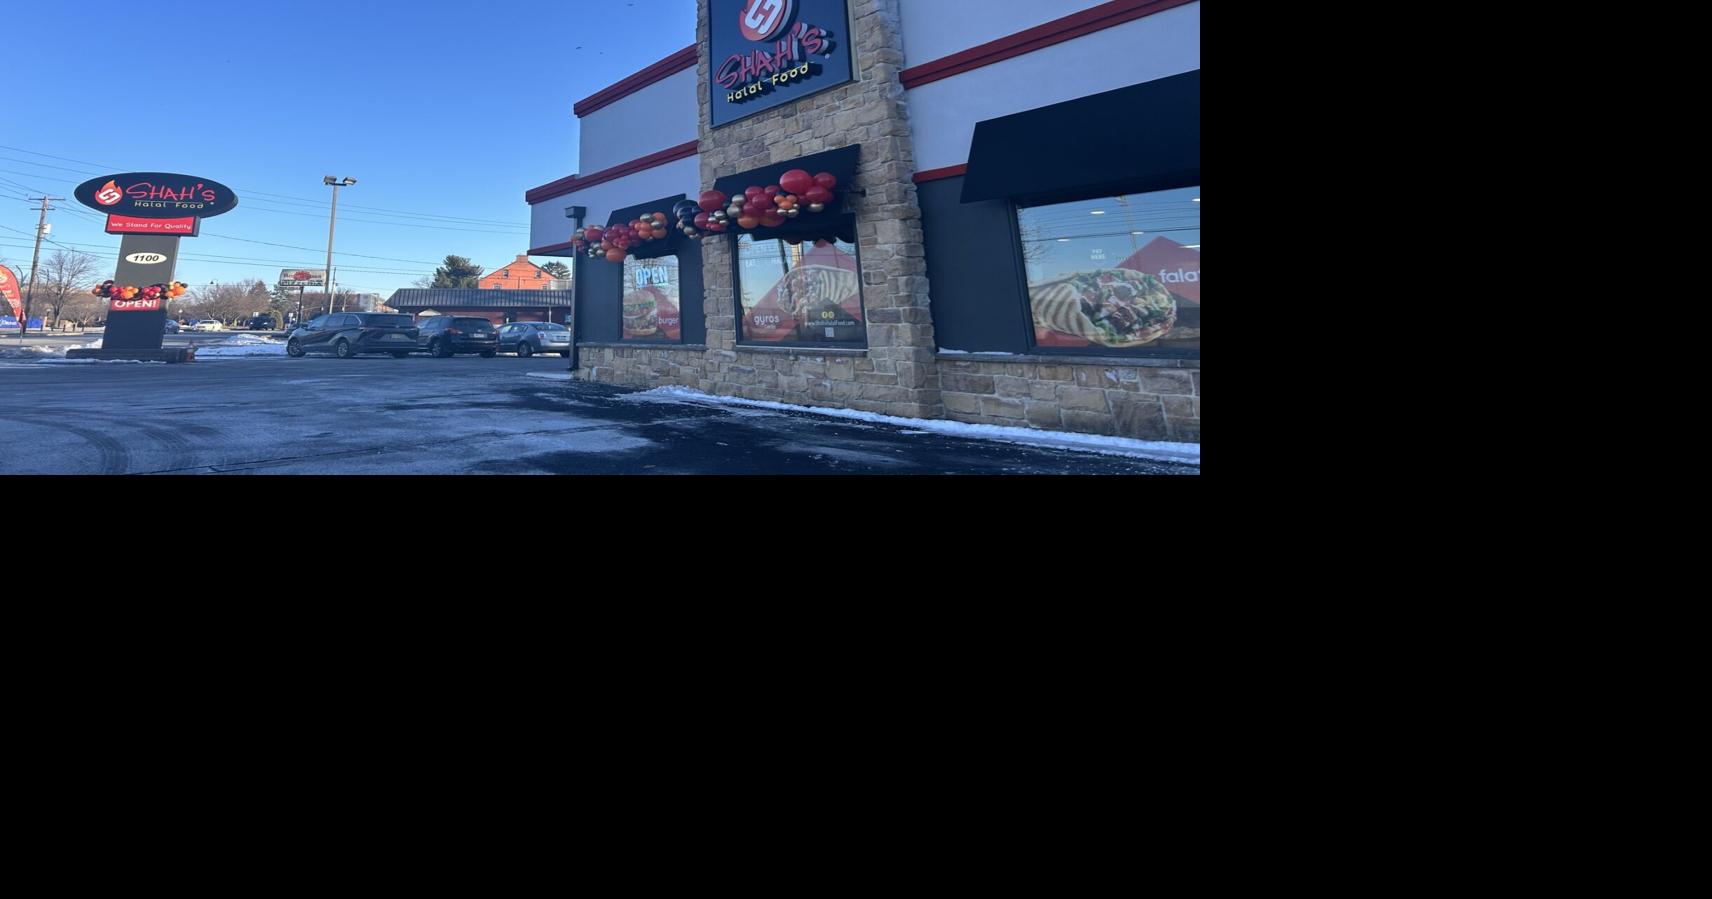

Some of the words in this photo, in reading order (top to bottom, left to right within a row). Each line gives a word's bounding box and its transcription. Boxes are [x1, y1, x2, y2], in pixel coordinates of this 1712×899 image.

[726, 81, 763, 103] Halal
[772, 62, 810, 86] Food
[175, 201, 204, 209] Food
[164, 222, 192, 230] Quality
[635, 265, 669, 287] OPEN
[1158, 268, 1200, 283] fala
[114, 299, 157, 308] OPEN!
[753, 315, 780, 326] gyros
